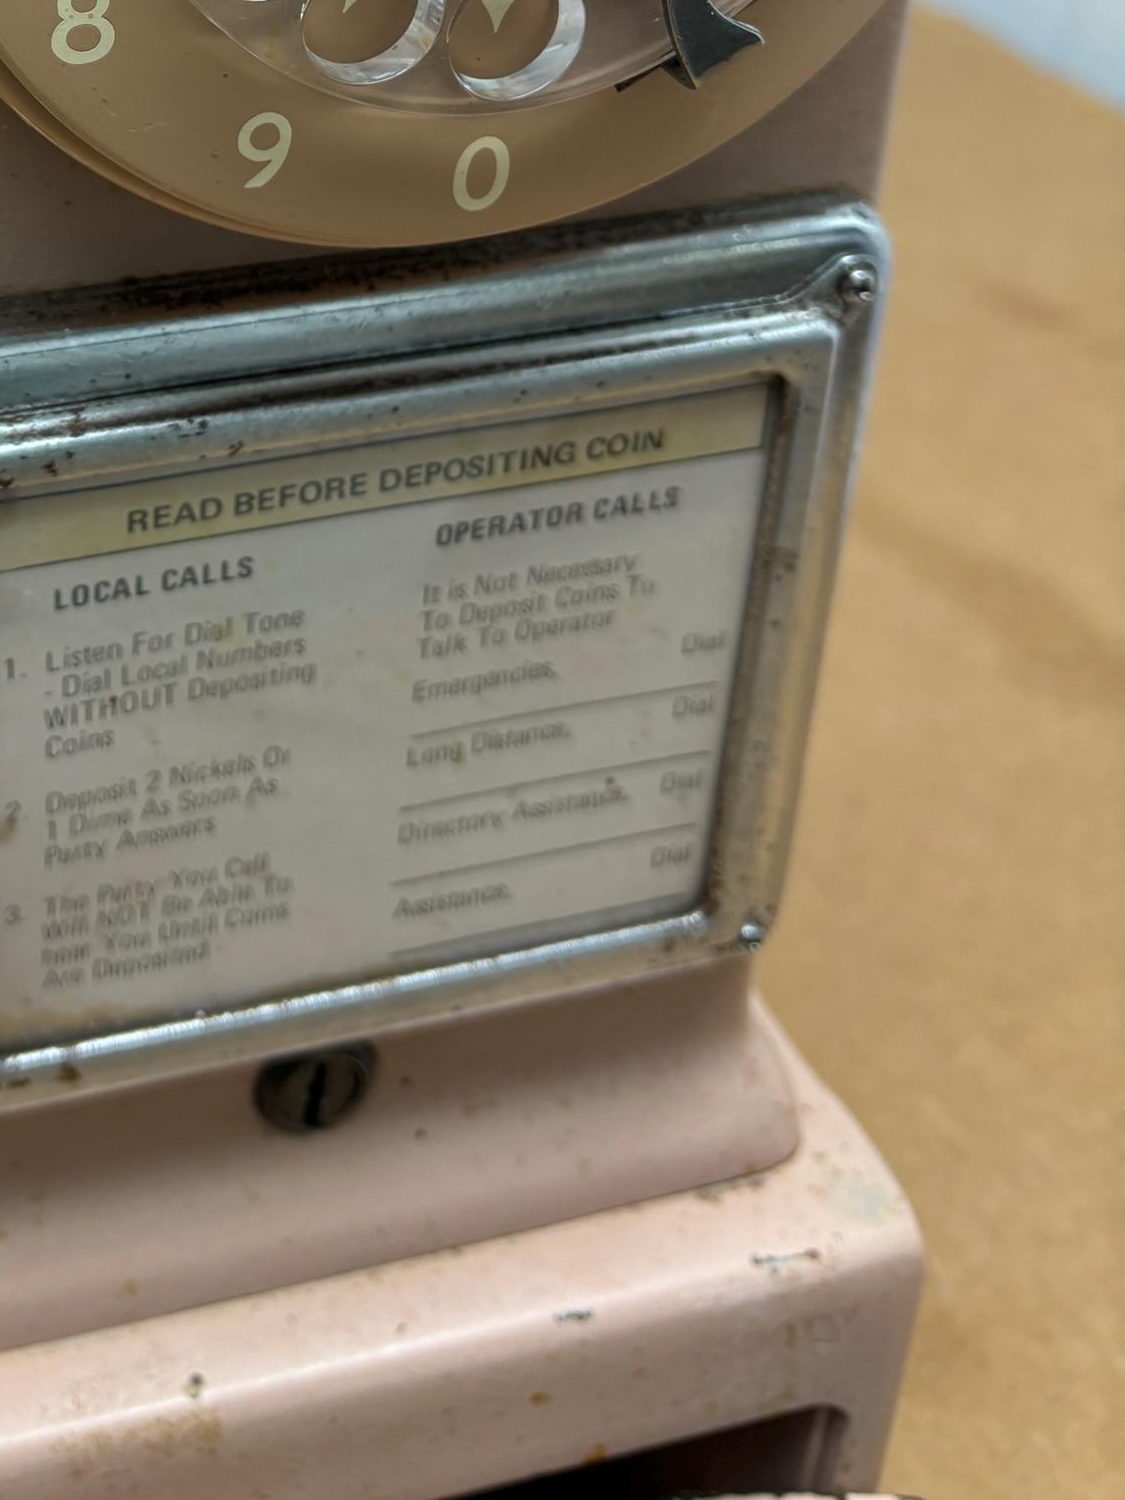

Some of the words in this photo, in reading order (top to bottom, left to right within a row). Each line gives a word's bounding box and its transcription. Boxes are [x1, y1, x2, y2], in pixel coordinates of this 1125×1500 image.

[238, 111, 293, 189] 9
[452, 135, 511, 211] 0
[127, 498, 222, 534] READ
[234, 473, 368, 516] BEFORE
[379, 440, 577, 492] DEPOSITING
[586, 427, 666, 460] COIN
[436, 504, 583, 546] OPERATOR
[594, 486, 682, 520] CALLS
[54, 576, 150, 610] LOCAL
[162, 556, 254, 591] CALLS
[473, 571, 520, 596] Not
[526, 553, 640, 586] Necessary
[45, 642, 124, 673] Listen
[131, 631, 174, 656] For
[185, 616, 234, 646] Dial
[243, 609, 305, 635] Tone
[61, 669, 112, 697] Dial
[121, 654, 189, 687] Local
[196, 638, 307, 671] Numbers
[43, 682, 179, 730] WITHOUT
[188, 662, 318, 701] Depositing
[144, 769, 163, 793] 2
